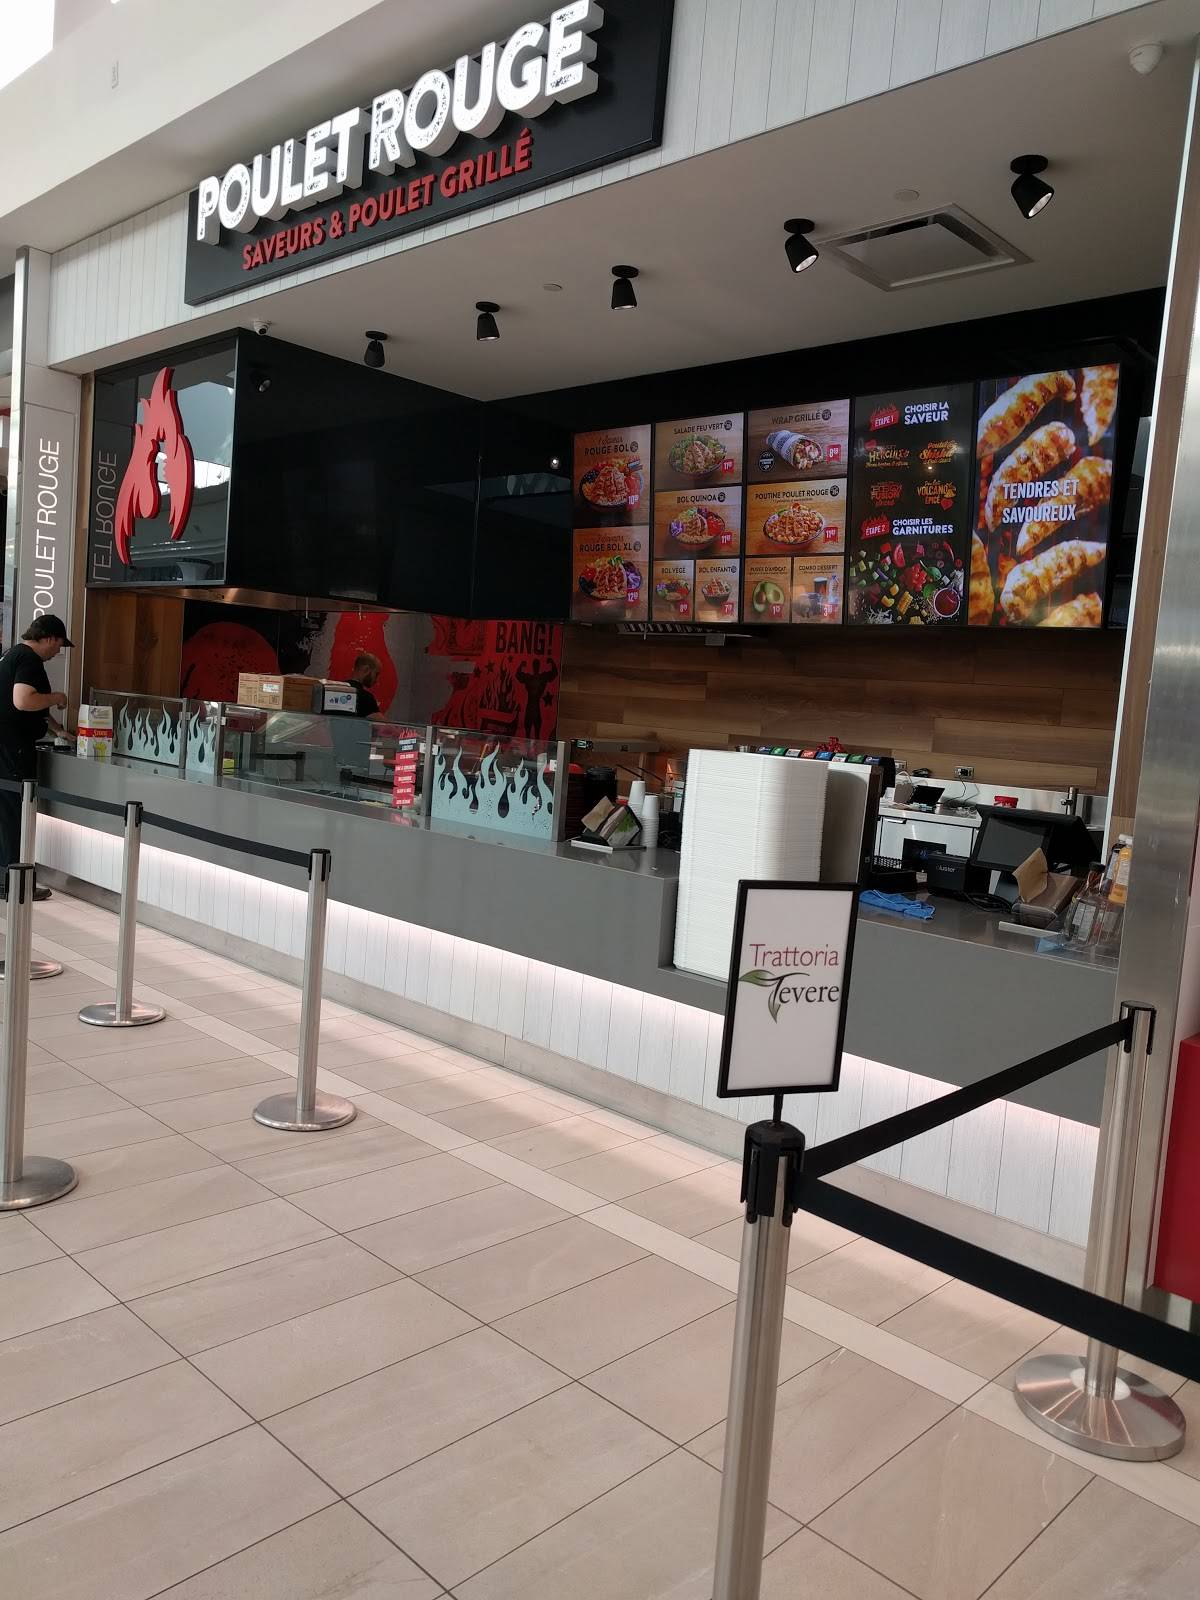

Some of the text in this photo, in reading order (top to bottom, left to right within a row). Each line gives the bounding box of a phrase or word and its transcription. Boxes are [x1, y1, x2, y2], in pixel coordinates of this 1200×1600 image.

[196, 0, 598, 243] POULET ROUGE
[241, 127, 535, 272] SAVEURS & POULET GRILLÉ
[904, 401, 950, 414] CHOISIR LA
[772, 410, 821, 425] WRAP GRILLÉ
[904, 411, 949, 425] SAVEUR
[674, 422, 724, 434] SALADE FEU VERT
[584, 445, 612, 456] ROUGE
[37, 438, 60, 526] ROUGE
[755, 488, 829, 500] POUTINE POULET ROUGE
[1002, 480, 1080, 499] TENDRES ET
[1002, 504, 1077, 523] SAVOUREUX
[921, 517, 933, 525] LES
[865, 524, 886, 536] ÉTAPE 2
[893, 525, 954, 535] GARNITURES
[623, 542, 632, 551] XL
[496, 621, 554, 656] BANG!
[750, 943, 839, 967] Trattoria
[767, 972, 840, 1009] Tevere
